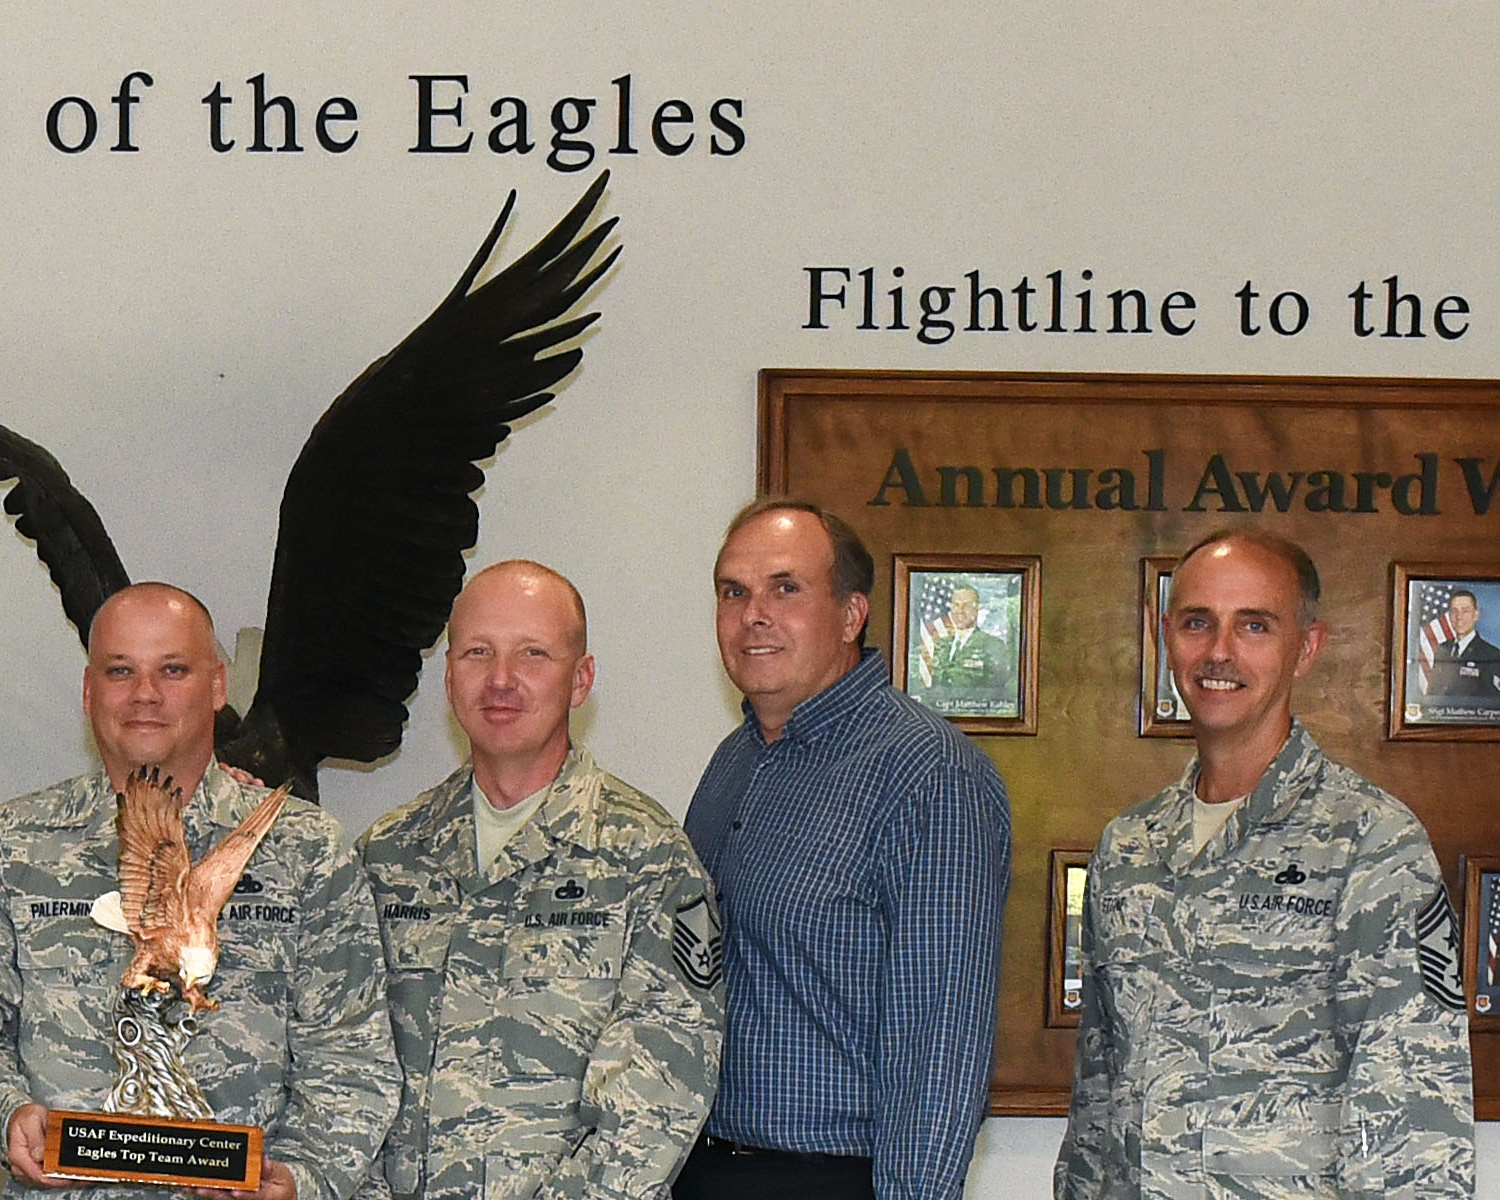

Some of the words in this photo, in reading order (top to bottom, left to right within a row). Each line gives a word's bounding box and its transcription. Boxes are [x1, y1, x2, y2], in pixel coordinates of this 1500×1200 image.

[45, 71, 155, 154] of
[201, 72, 360, 153] the
[407, 73, 748, 172] Eagles
[801, 266, 1198, 344] Flightline
[1234, 279, 1311, 338] to
[1348, 276, 1472, 340] the
[866, 448, 1168, 512] Annual
[1181, 453, 1442, 516] Award
[229, 904, 252, 920] AIR
[255, 905, 296, 924] FORCE
[1286, 895, 1332, 916] FORCE
[548, 912, 568, 926] AIR
[570, 911, 610, 927] FORCE
[68, 1126, 106, 1140] USAF
[108, 1129, 197, 1149] Expeditionary
[199, 1136, 242, 1151] Center
[77, 1146, 118, 1161] Eagles
[120, 1149, 146, 1164] Top
[148, 1151, 184, 1165] Team
[187, 1155, 230, 1169] Award
